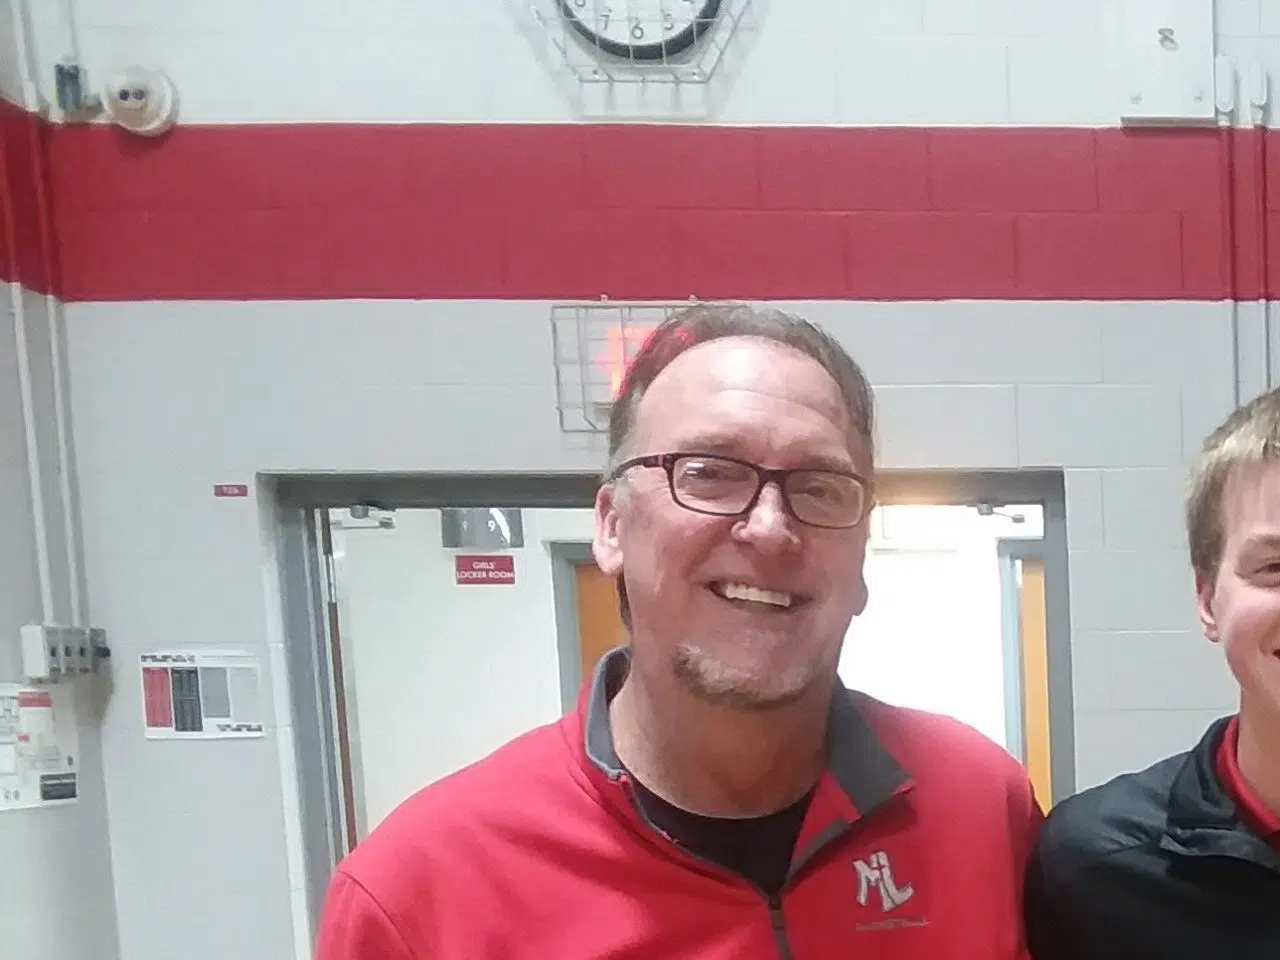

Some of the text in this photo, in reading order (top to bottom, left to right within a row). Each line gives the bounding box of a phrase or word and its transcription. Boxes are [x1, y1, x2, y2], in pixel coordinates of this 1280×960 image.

[600, 14, 610, 31] 7
[631, 16, 644, 40] 6
[662, 12, 674, 31] 5
[456, 571, 514, 579] LOCKER ROOM
